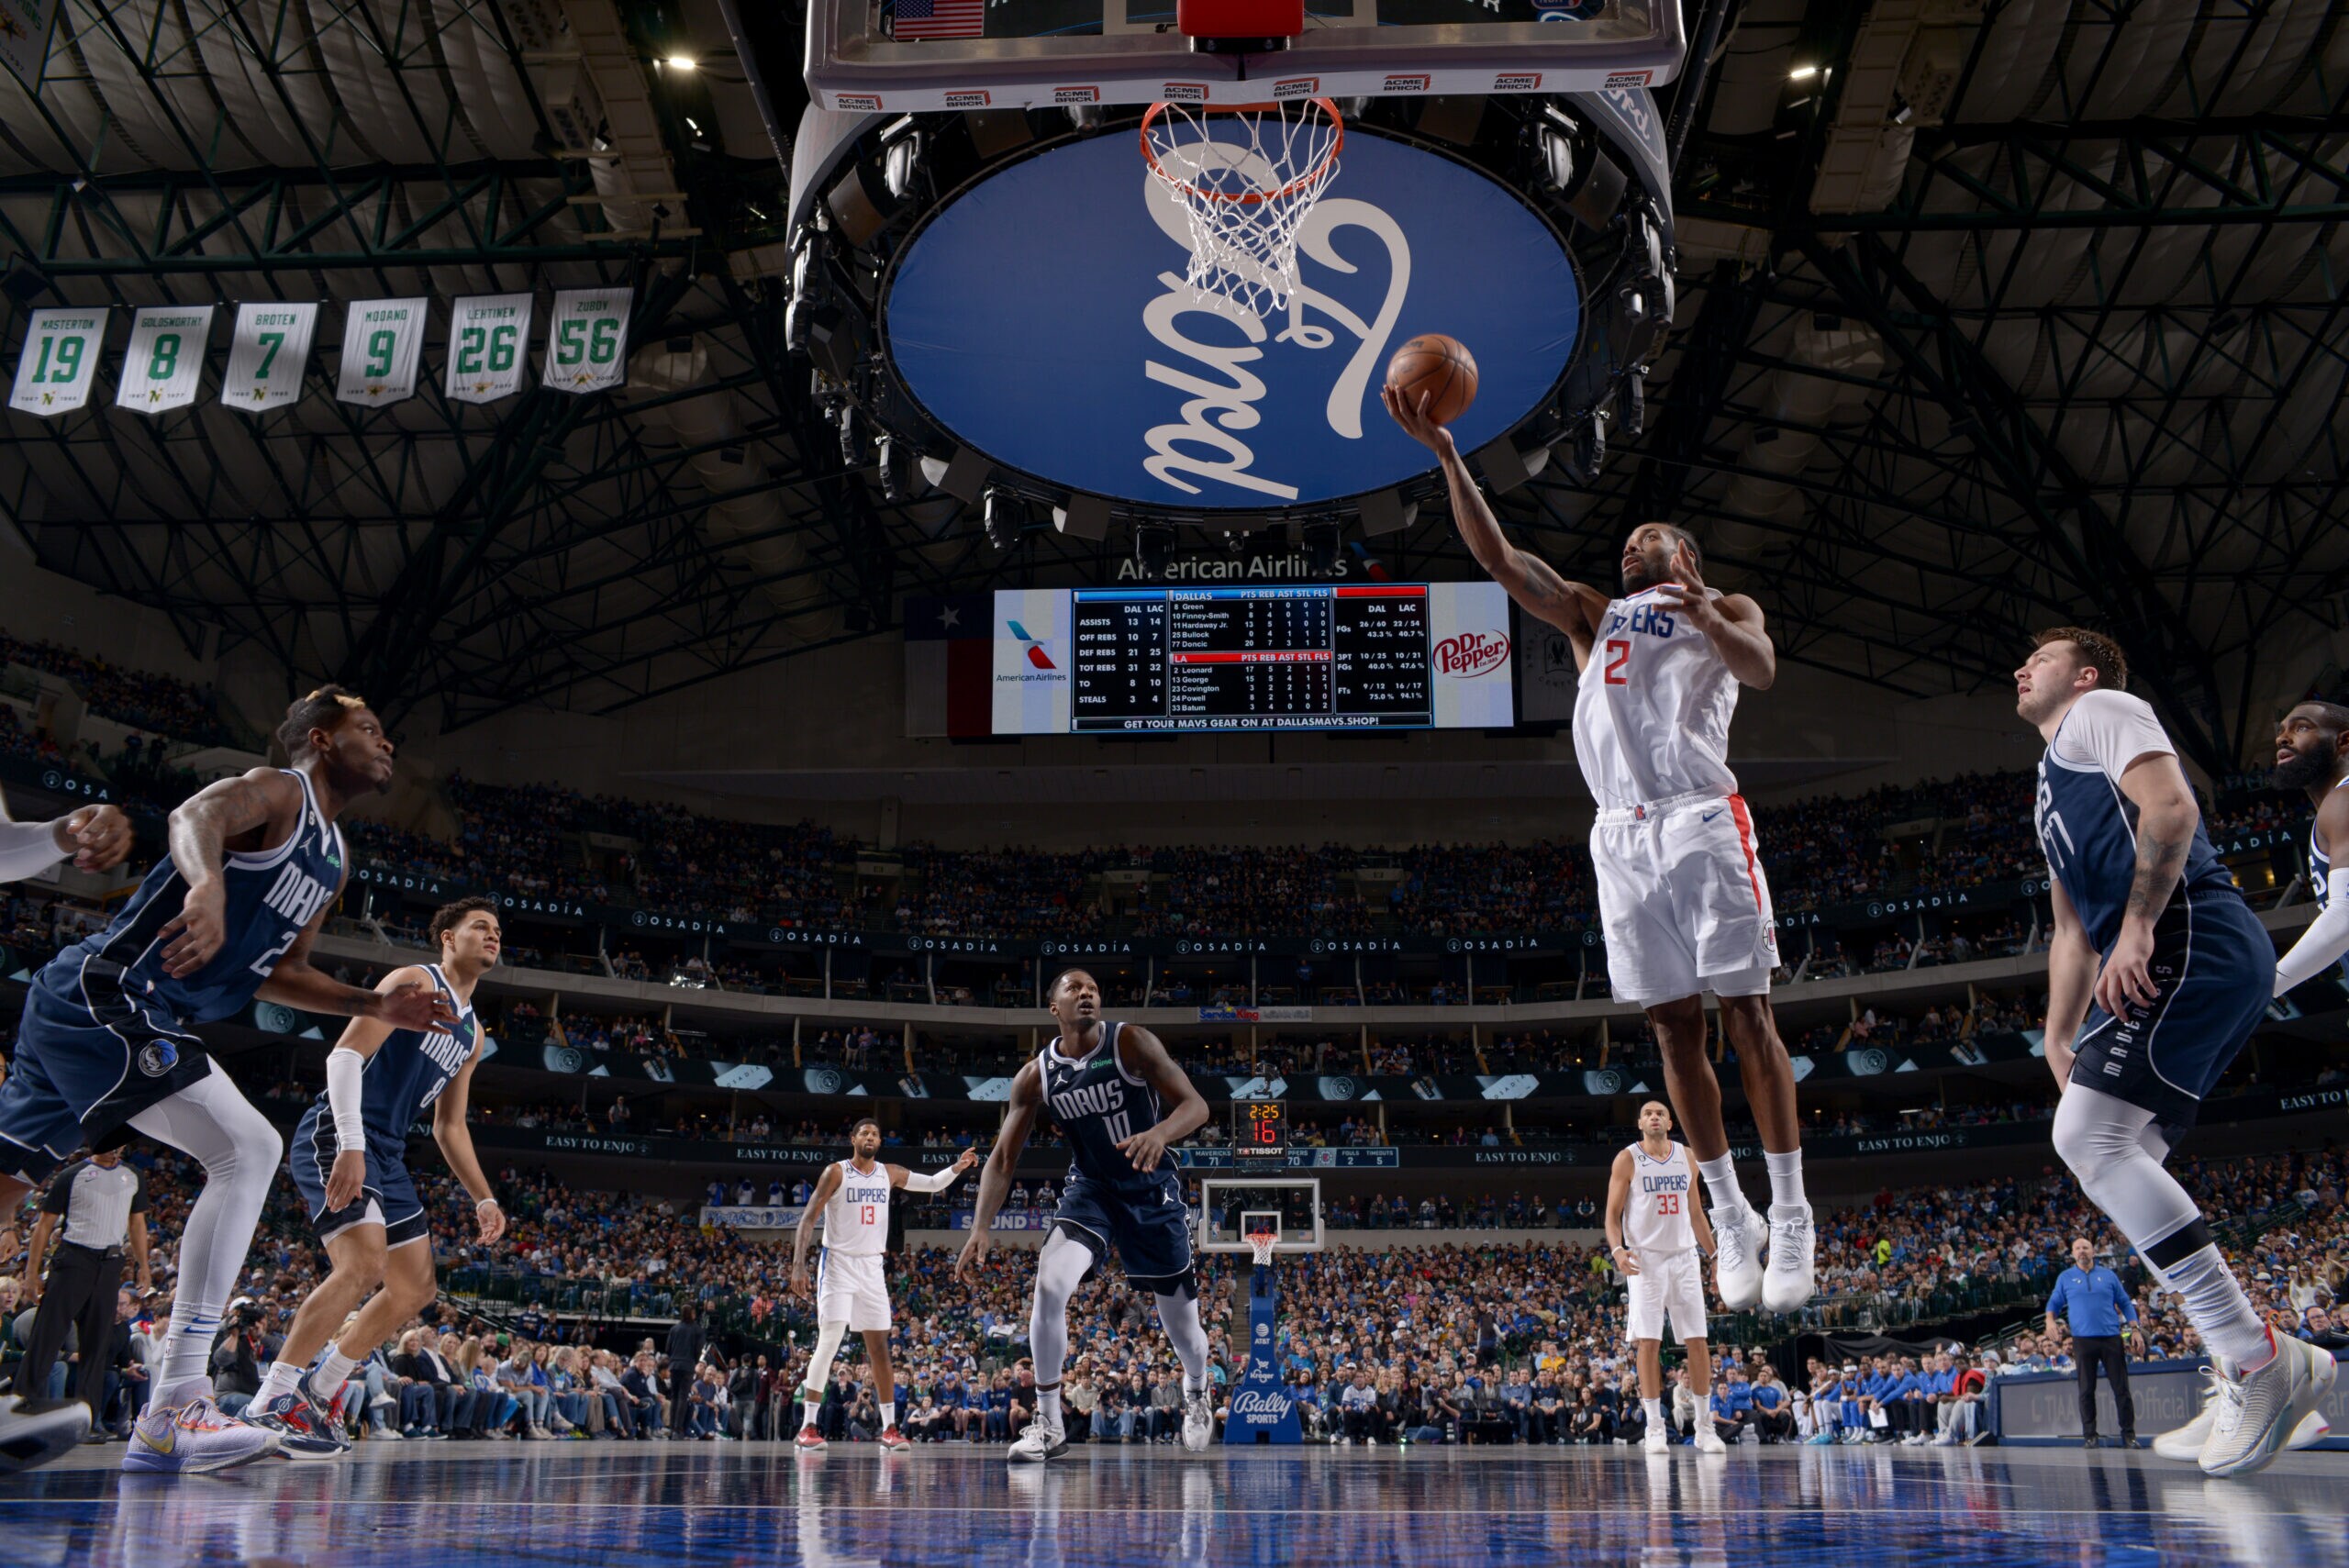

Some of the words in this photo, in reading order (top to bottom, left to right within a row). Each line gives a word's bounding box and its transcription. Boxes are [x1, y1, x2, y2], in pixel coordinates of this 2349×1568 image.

[467, 306, 516, 320] LEHTINEN
[576, 301, 608, 312] ZUBOV
[141, 317, 204, 328] GOLDSWORTHY
[255, 315, 296, 326] BROTEN
[366, 308, 407, 322] MODANO
[1143, 141, 1411, 501] Ford
[41, 318, 95, 330] MASTERTON
[556, 317, 619, 365] 56
[148, 333, 181, 381] 8
[254, 332, 285, 379] 7
[365, 330, 396, 378] 9
[456, 326, 518, 374] 26
[31, 336, 85, 384] 19
[1175, 593, 1212, 601] DALLAS
[1241, 590, 1256, 598] PTS
[1259, 590, 1275, 598] REB
[1297, 589, 1311, 597] STL
[1368, 605, 1386, 613] DAL
[1398, 604, 1416, 612] LAC
[1128, 633, 1139, 641] 10
[1458, 632, 1486, 653] Dr
[1260, 653, 1276, 662] REB
[1315, 652, 1329, 661] FLS
[1434, 639, 1505, 674] Pepper
[1604, 639, 1630, 685] 2
[1124, 719, 1142, 728] GET
[1146, 719, 1174, 728] YOUR
[1177, 718, 1208, 728] MAVS
[1210, 718, 1238, 728] GEAR
[1241, 717, 1258, 727] ON
[1261, 717, 1275, 727] AT
[1276, 717, 1379, 727] DALLASMAVS.SHOP!
[2043, 810, 2075, 870] 77
[2216, 830, 2293, 855] SADÍA
[1048, 1061, 1055, 1070] 6
[1091, 1059, 1112, 1069] chime
[420, 1076, 447, 1108] 8
[2281, 1094, 2315, 1110] EASY
[2319, 1090, 2341, 1104] TO
[1250, 1105, 1279, 1119] 2:25
[1102, 1109, 1131, 1146] 10
[1253, 1120, 1276, 1143] 16
[545, 1136, 579, 1150] EASY
[582, 1138, 601, 1151] TO
[1858, 1140, 1889, 1151] EASY
[1892, 1138, 1912, 1149] TO
[737, 1148, 768, 1160] EASY
[771, 1149, 790, 1160] TO
[1209, 1157, 1219, 1166] 71
[1288, 1157, 1301, 1166] 70
[1347, 1157, 1354, 1165] 2
[1376, 1157, 1383, 1165] 5
[1475, 1151, 1506, 1162] EASY
[1507, 1152, 1527, 1162] TO
[1642, 1174, 1687, 1193] CLIPPERS
[847, 1187, 886, 1203] CLIPPERS
[1657, 1195, 1679, 1215] 33
[861, 1206, 874, 1225] 13
[1250, 1369, 1274, 1384] Kroger
[1233, 1391, 1292, 1419] Bally
[1246, 1414, 1278, 1424] SPORTS
